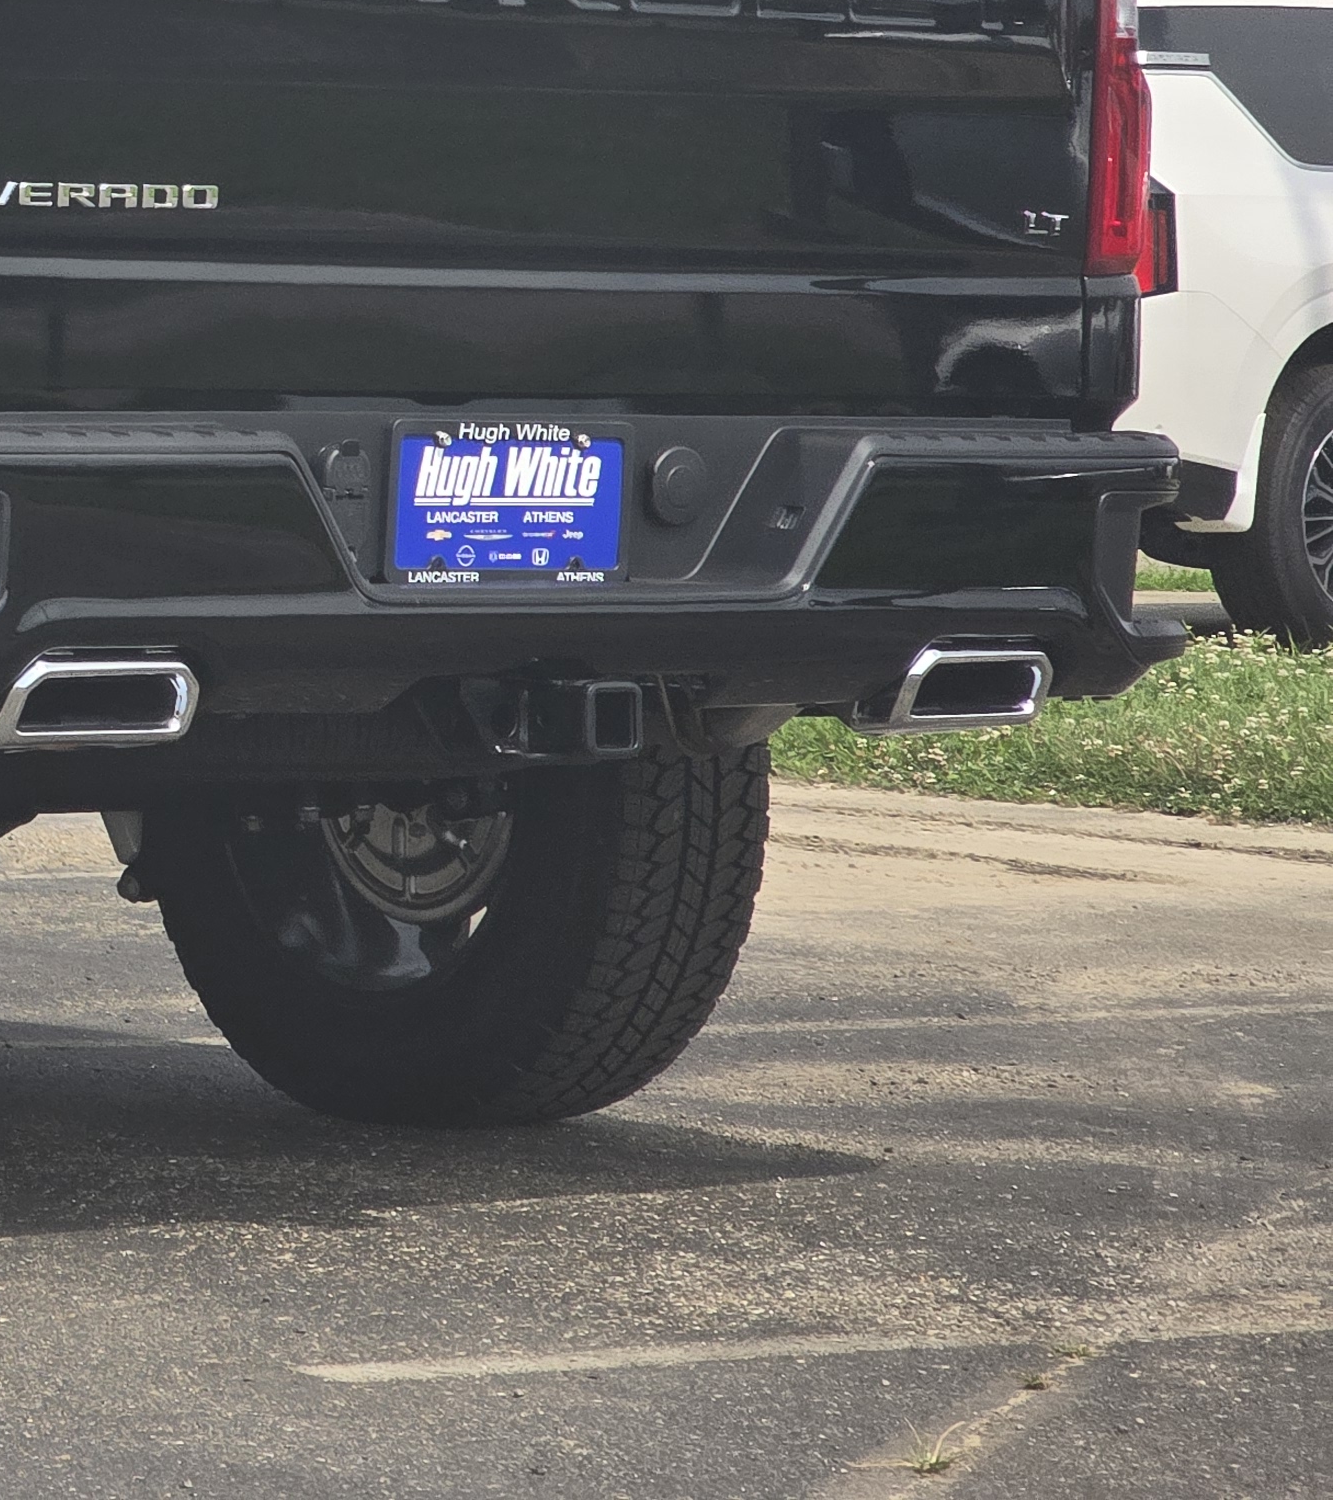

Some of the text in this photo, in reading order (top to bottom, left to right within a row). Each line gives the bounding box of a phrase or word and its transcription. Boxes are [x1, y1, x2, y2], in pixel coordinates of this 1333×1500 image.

[1023, 210, 1070, 236] LT
[458, 422, 571, 443] Hugh White
[415, 446, 602, 506] Hugh White
[426, 511, 499, 524] LANCASTER
[523, 511, 574, 524] ATHENS
[562, 529, 584, 539] Jeep
[407, 571, 480, 584] LANCASTER
[556, 571, 605, 583] ATHENS
